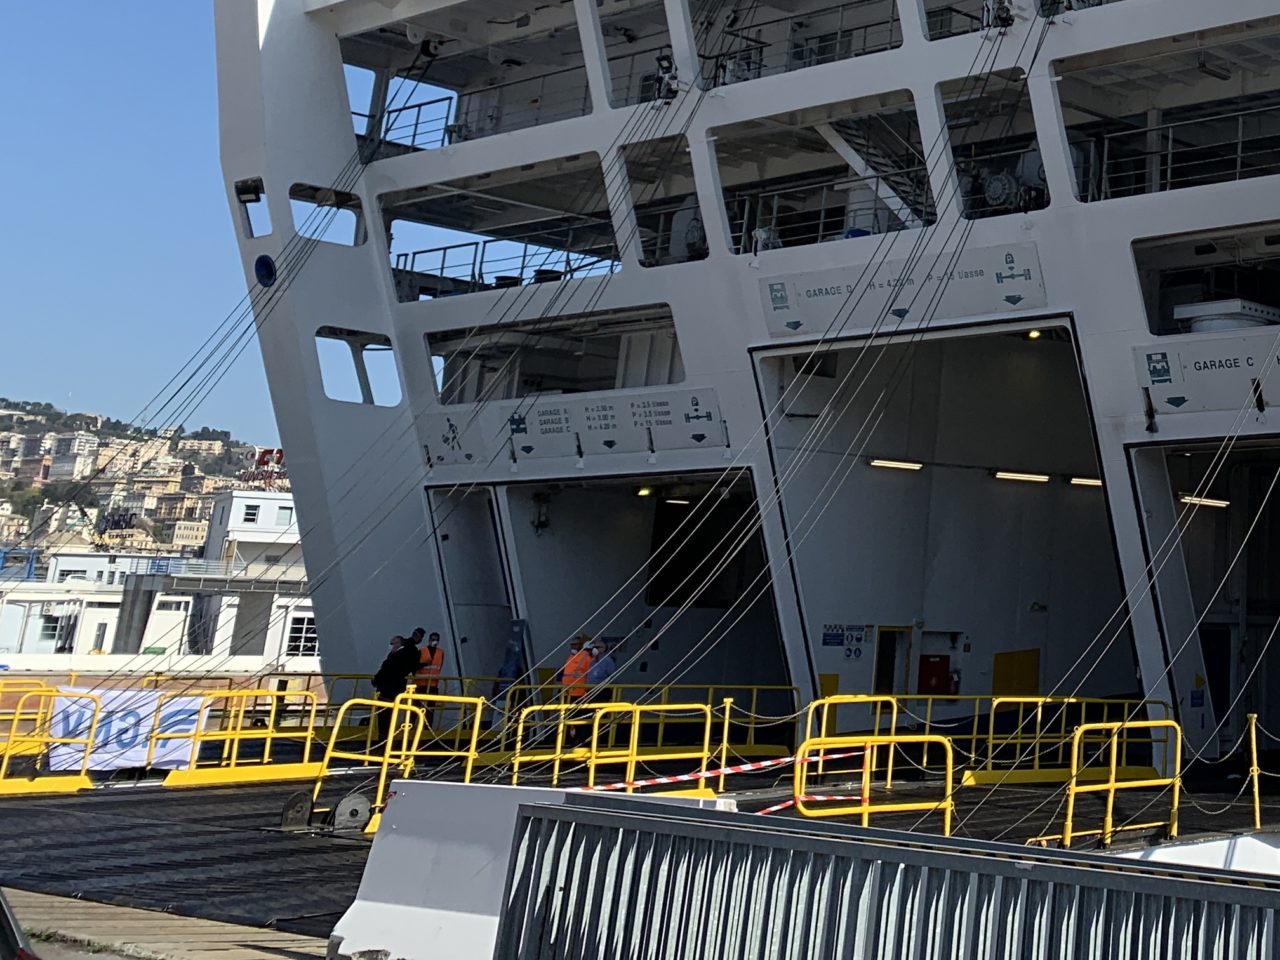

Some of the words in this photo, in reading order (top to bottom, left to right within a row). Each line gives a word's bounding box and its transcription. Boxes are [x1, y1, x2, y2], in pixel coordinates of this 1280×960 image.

[805, 285, 843, 299] GARAGE
[869, 280, 877, 290] H
[1193, 357, 1241, 372] GARAGE
[1246, 356, 1254, 367] C
[537, 409, 561, 418] GARAGE
[538, 417, 562, 427] GARAGE
[540, 426, 564, 435] GARAGE
